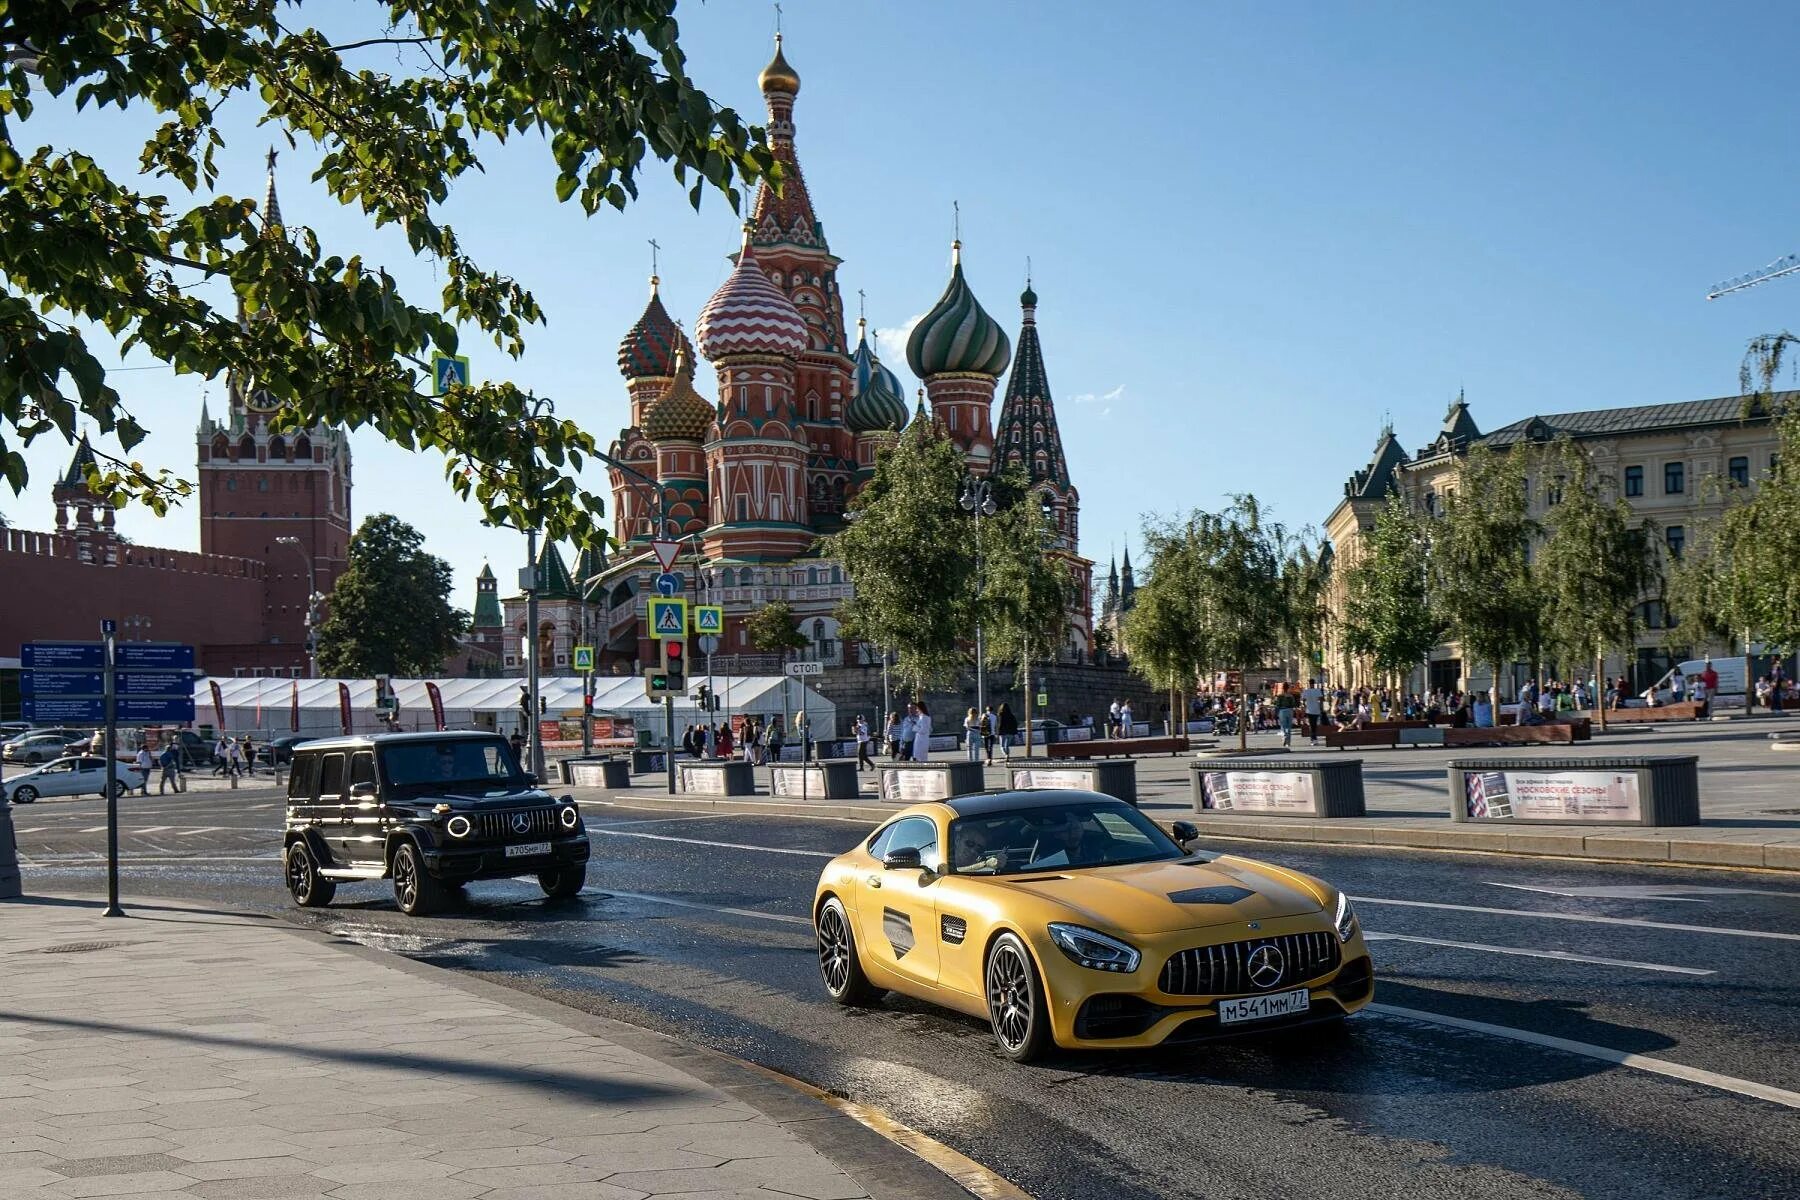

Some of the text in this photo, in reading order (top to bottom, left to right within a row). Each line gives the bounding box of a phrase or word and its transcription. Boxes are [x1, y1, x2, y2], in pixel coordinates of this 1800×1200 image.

[793, 664, 818, 673] СТОП
[1516, 786, 1607, 795] МОСКОВСКИЕ СЕЗОНЫ
[1226, 991, 1304, 1019] М541ММ 77
